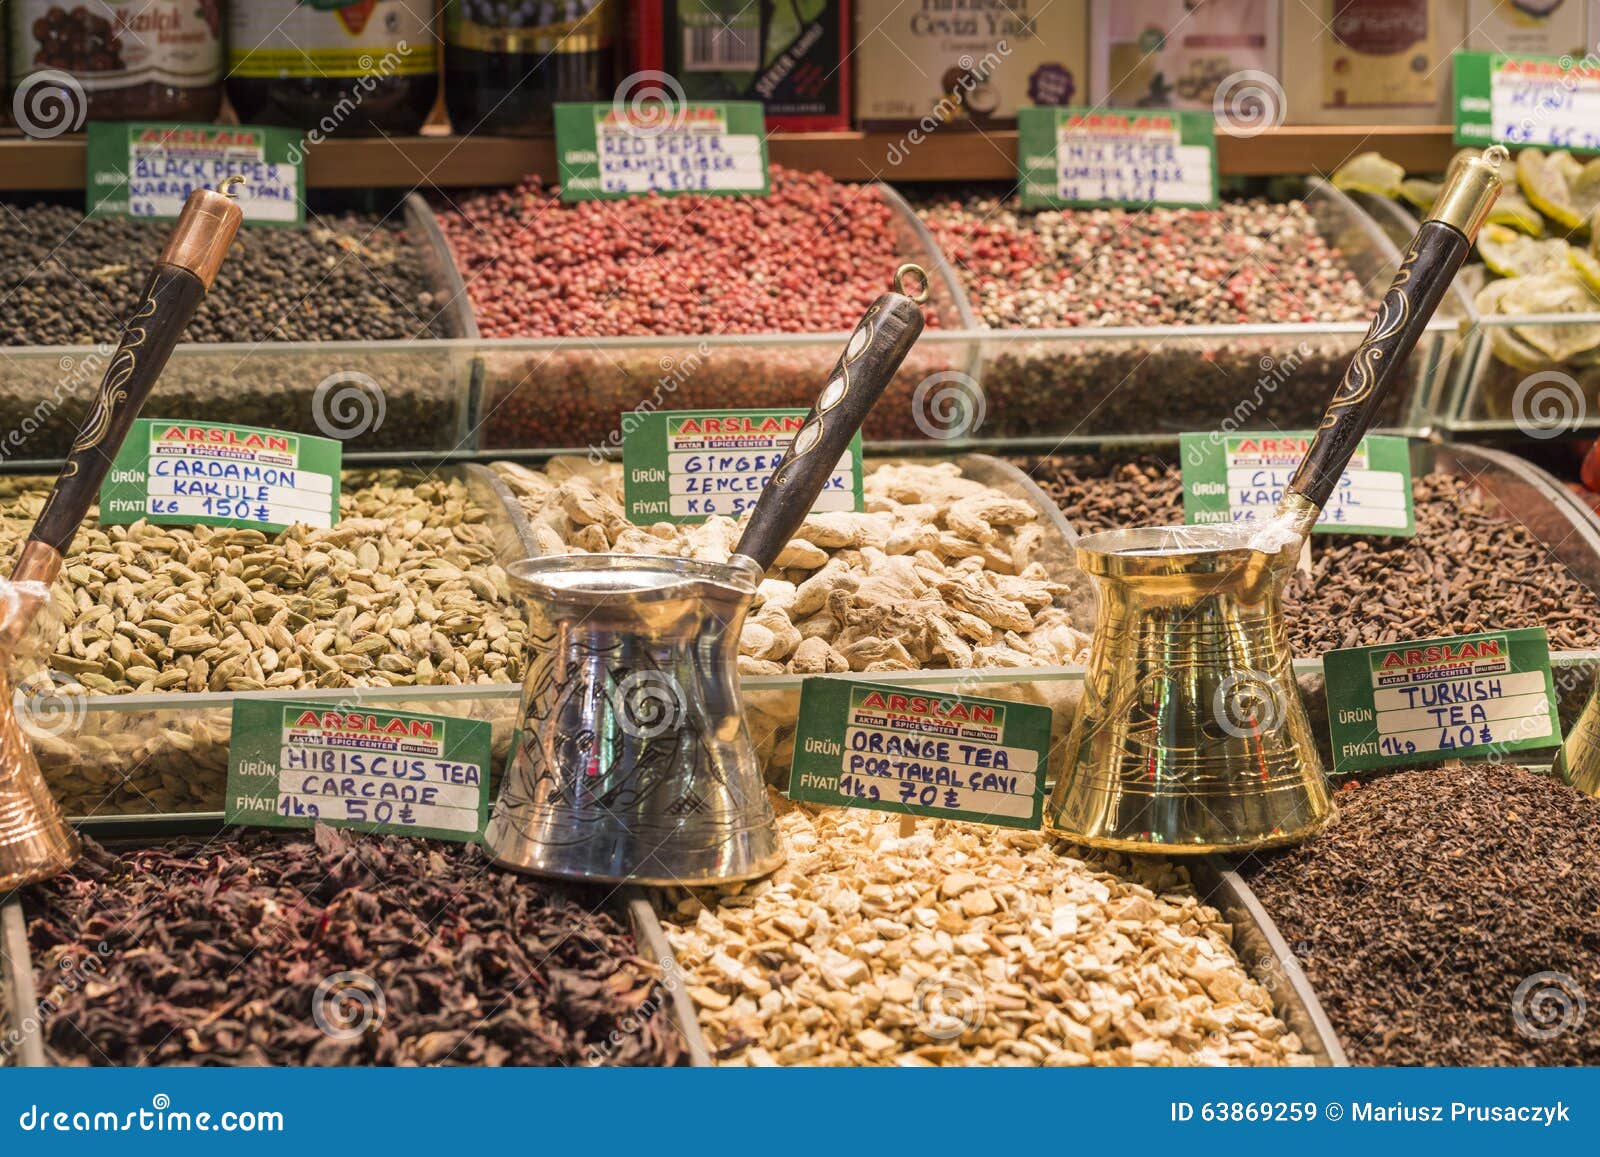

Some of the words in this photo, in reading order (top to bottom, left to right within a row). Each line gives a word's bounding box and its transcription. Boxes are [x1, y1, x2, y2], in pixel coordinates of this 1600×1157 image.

[604, 137, 647, 154] RED
[655, 136, 725, 154] PEPER
[136, 158, 208, 179] BLACK
[213, 160, 280, 182] PEPER
[680, 416, 804, 434] ARSLAN
[163, 425, 289, 451] ARSLAN
[737, 440, 769, 448] CENTER
[194, 448, 219, 457] SPICE
[219, 450, 252, 460] CENTER
[111, 470, 145, 483] ÜRÜN
[155, 459, 297, 488] CARDAMON
[632, 469, 665, 482] ÜRÜN
[173, 479, 269, 501] KAKULE
[1192, 481, 1226, 496] ÜRÜN
[109, 498, 145, 512] FİYATI
[152, 499, 179, 513] KG
[632, 500, 668, 515] FİYATI
[687, 499, 716, 514] KG
[1382, 639, 1499, 669] ARSLAN
[1382, 676, 1407, 686] AKTAR
[1416, 671, 1439, 681] SPICE
[1440, 668, 1469, 678] CENTER
[1398, 679, 1503, 709] TURKISH
[863, 691, 995, 724] ARSLAN
[1338, 708, 1373, 725] ÜRÜN
[1427, 703, 1488, 728] TEA
[295, 710, 434, 739] ARSLAN
[858, 716, 884, 726] AKTAR
[895, 720, 921, 731] SPICE
[921, 724, 956, 735] CENTER
[331, 737, 358, 747] SPICE
[359, 740, 394, 750] CENTER
[805, 738, 841, 756] ÜRÜN
[852, 730, 950, 763] ORANGE
[959, 744, 1009, 770] TEA
[1342, 742, 1378, 758] FİYATI
[238, 759, 276, 776] ÜRÜN
[288, 748, 427, 781] HIBISCUS
[435, 762, 480, 785] TEA
[850, 754, 963, 788] PORTAKAL
[968, 771, 1017, 793] ÇAYI
[301, 775, 439, 805] CARCADE
[800, 771, 838, 791] FİYATI
[840, 775, 881, 802] 1kg
[236, 796, 275, 811] FİYATI
[279, 795, 320, 821] 1kg
